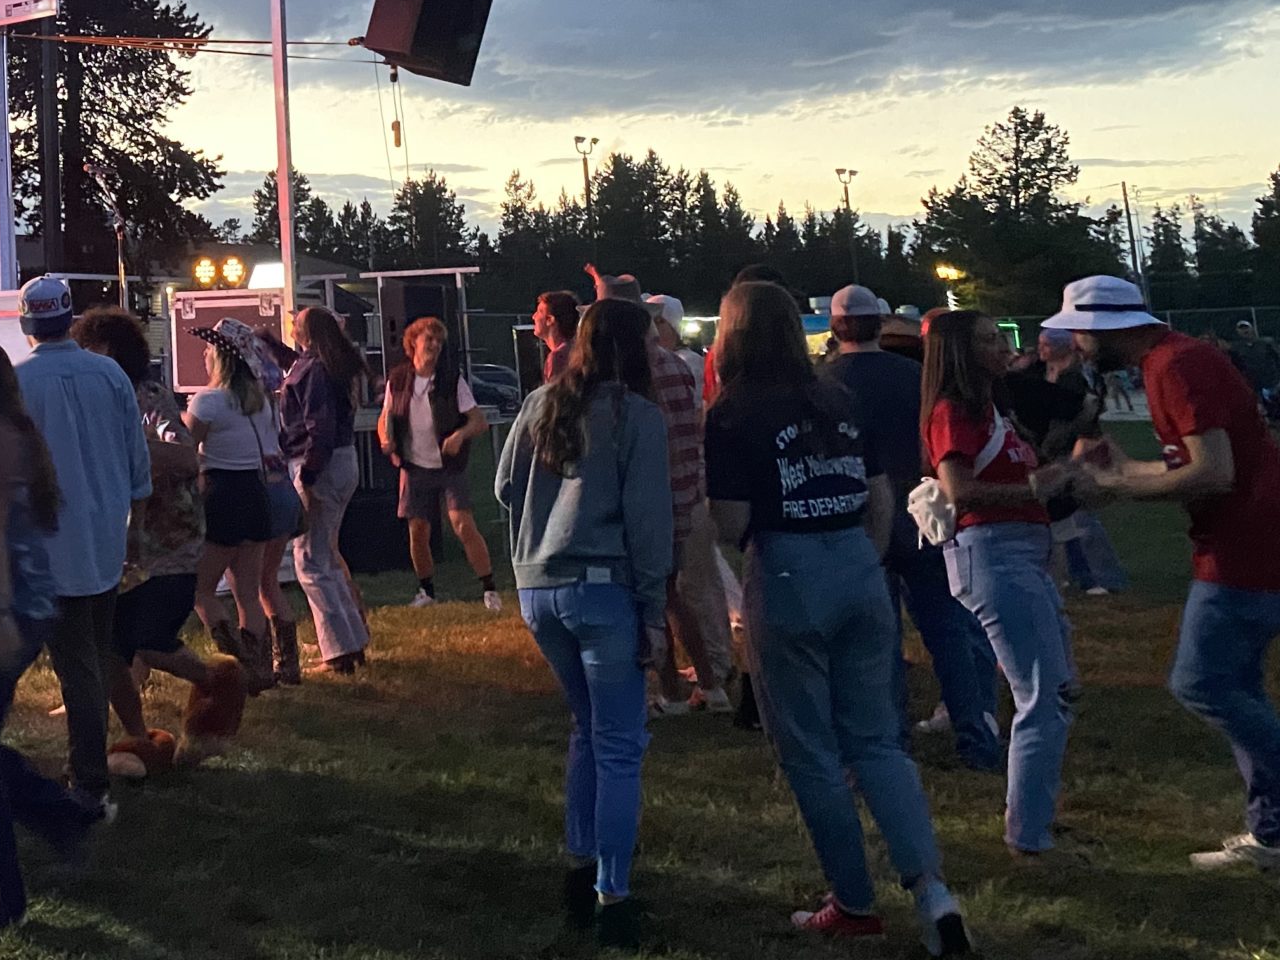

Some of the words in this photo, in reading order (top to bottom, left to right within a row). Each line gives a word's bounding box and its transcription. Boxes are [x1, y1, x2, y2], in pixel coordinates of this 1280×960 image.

[777, 458, 807, 496] West
[783, 500, 809, 519] FIRE
[808, 491, 869, 517] DEPART
